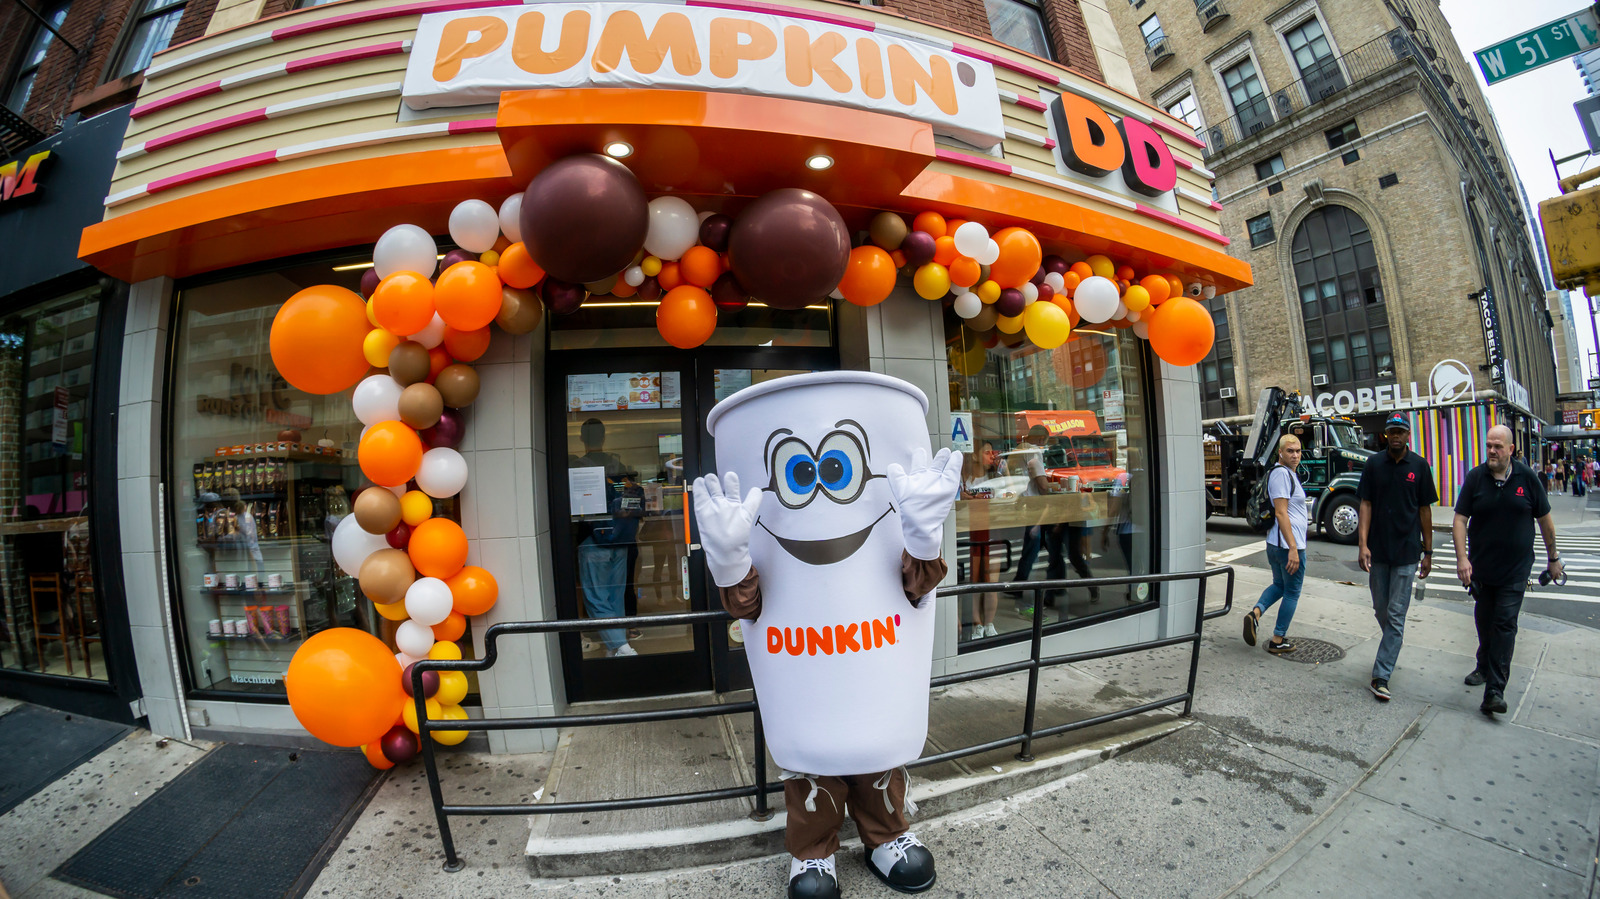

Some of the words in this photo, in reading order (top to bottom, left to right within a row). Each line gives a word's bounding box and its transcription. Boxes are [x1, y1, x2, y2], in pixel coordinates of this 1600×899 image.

[432, 10, 976, 116] PUMPKIN'
[1481, 48, 1506, 78] W
[1516, 33, 1549, 66] 51
[1551, 22, 1570, 40] ST
[1480, 291, 1492, 329] TACO
[1486, 329, 1498, 364] BELL
[1298, 389, 1355, 417] ACO
[1356, 381, 1429, 413] BELL
[951, 417, 969, 441] A
[767, 613, 901, 656] DUNKIN'
[230, 674, 276, 685] Macchiato
